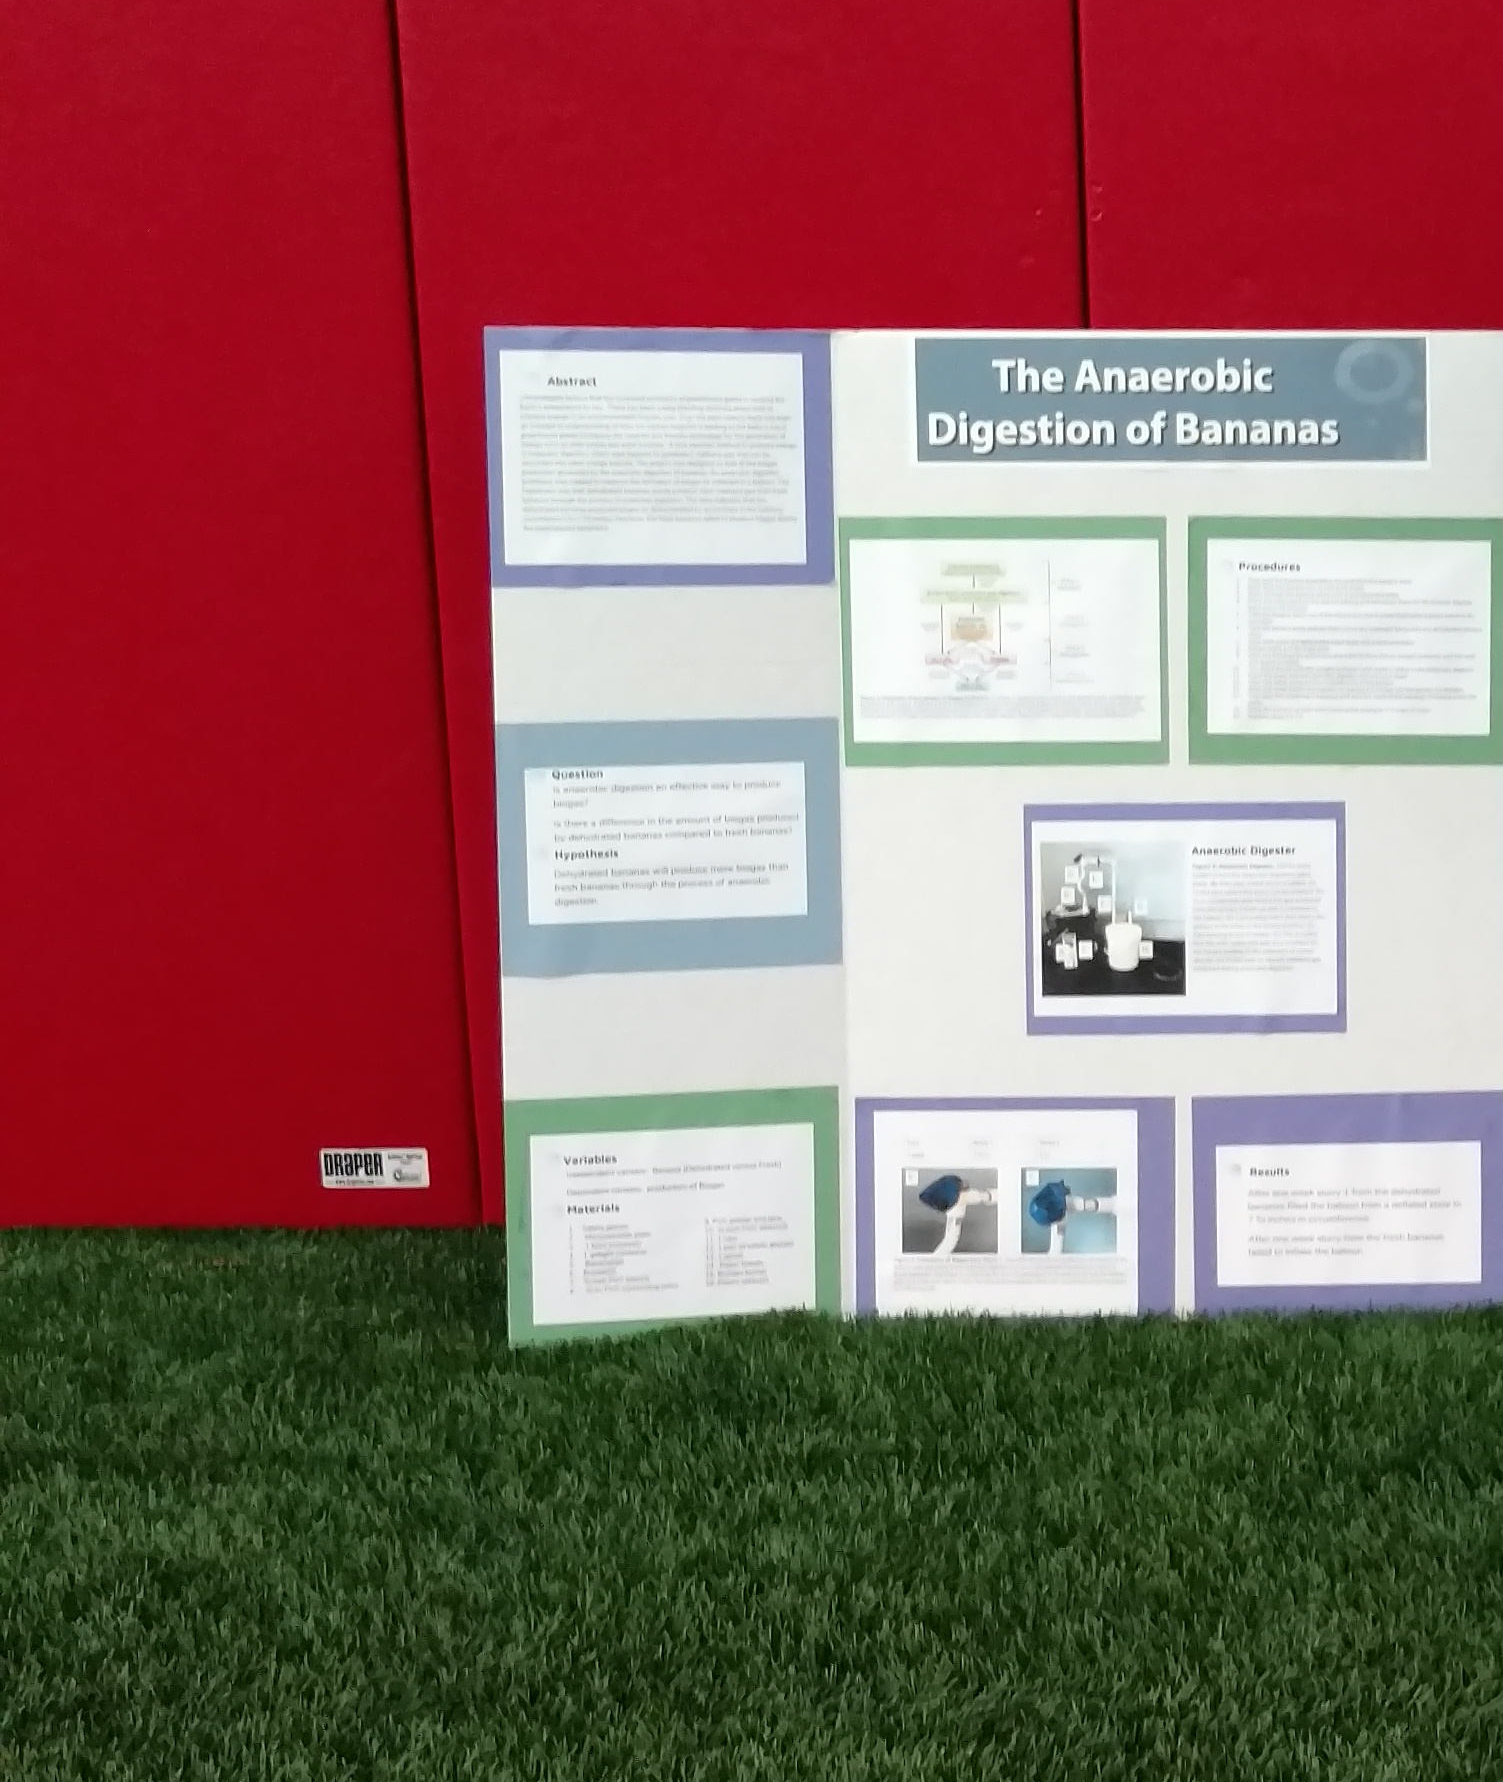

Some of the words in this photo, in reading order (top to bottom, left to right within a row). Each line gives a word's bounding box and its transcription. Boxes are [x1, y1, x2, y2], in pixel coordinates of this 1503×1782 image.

[547, 376, 597, 387] Abstract
[992, 358, 1065, 394] The
[1075, 358, 1273, 394] Anaerobic
[927, 411, 1116, 455] Digestion
[1126, 410, 1168, 446] of
[1176, 411, 1340, 446] Bananas
[1238, 561, 1301, 573] Procedures
[552, 770, 604, 780] Question
[554, 848, 619, 862] Hypothesis
[1192, 846, 1246, 856] Anaerobic
[1250, 845, 1296, 857] Digester
[323, 1153, 383, 1177] DRAPER
[563, 1154, 617, 1166] Variables
[1249, 1167, 1290, 1177] Results
[567, 1203, 620, 1215] Materials
